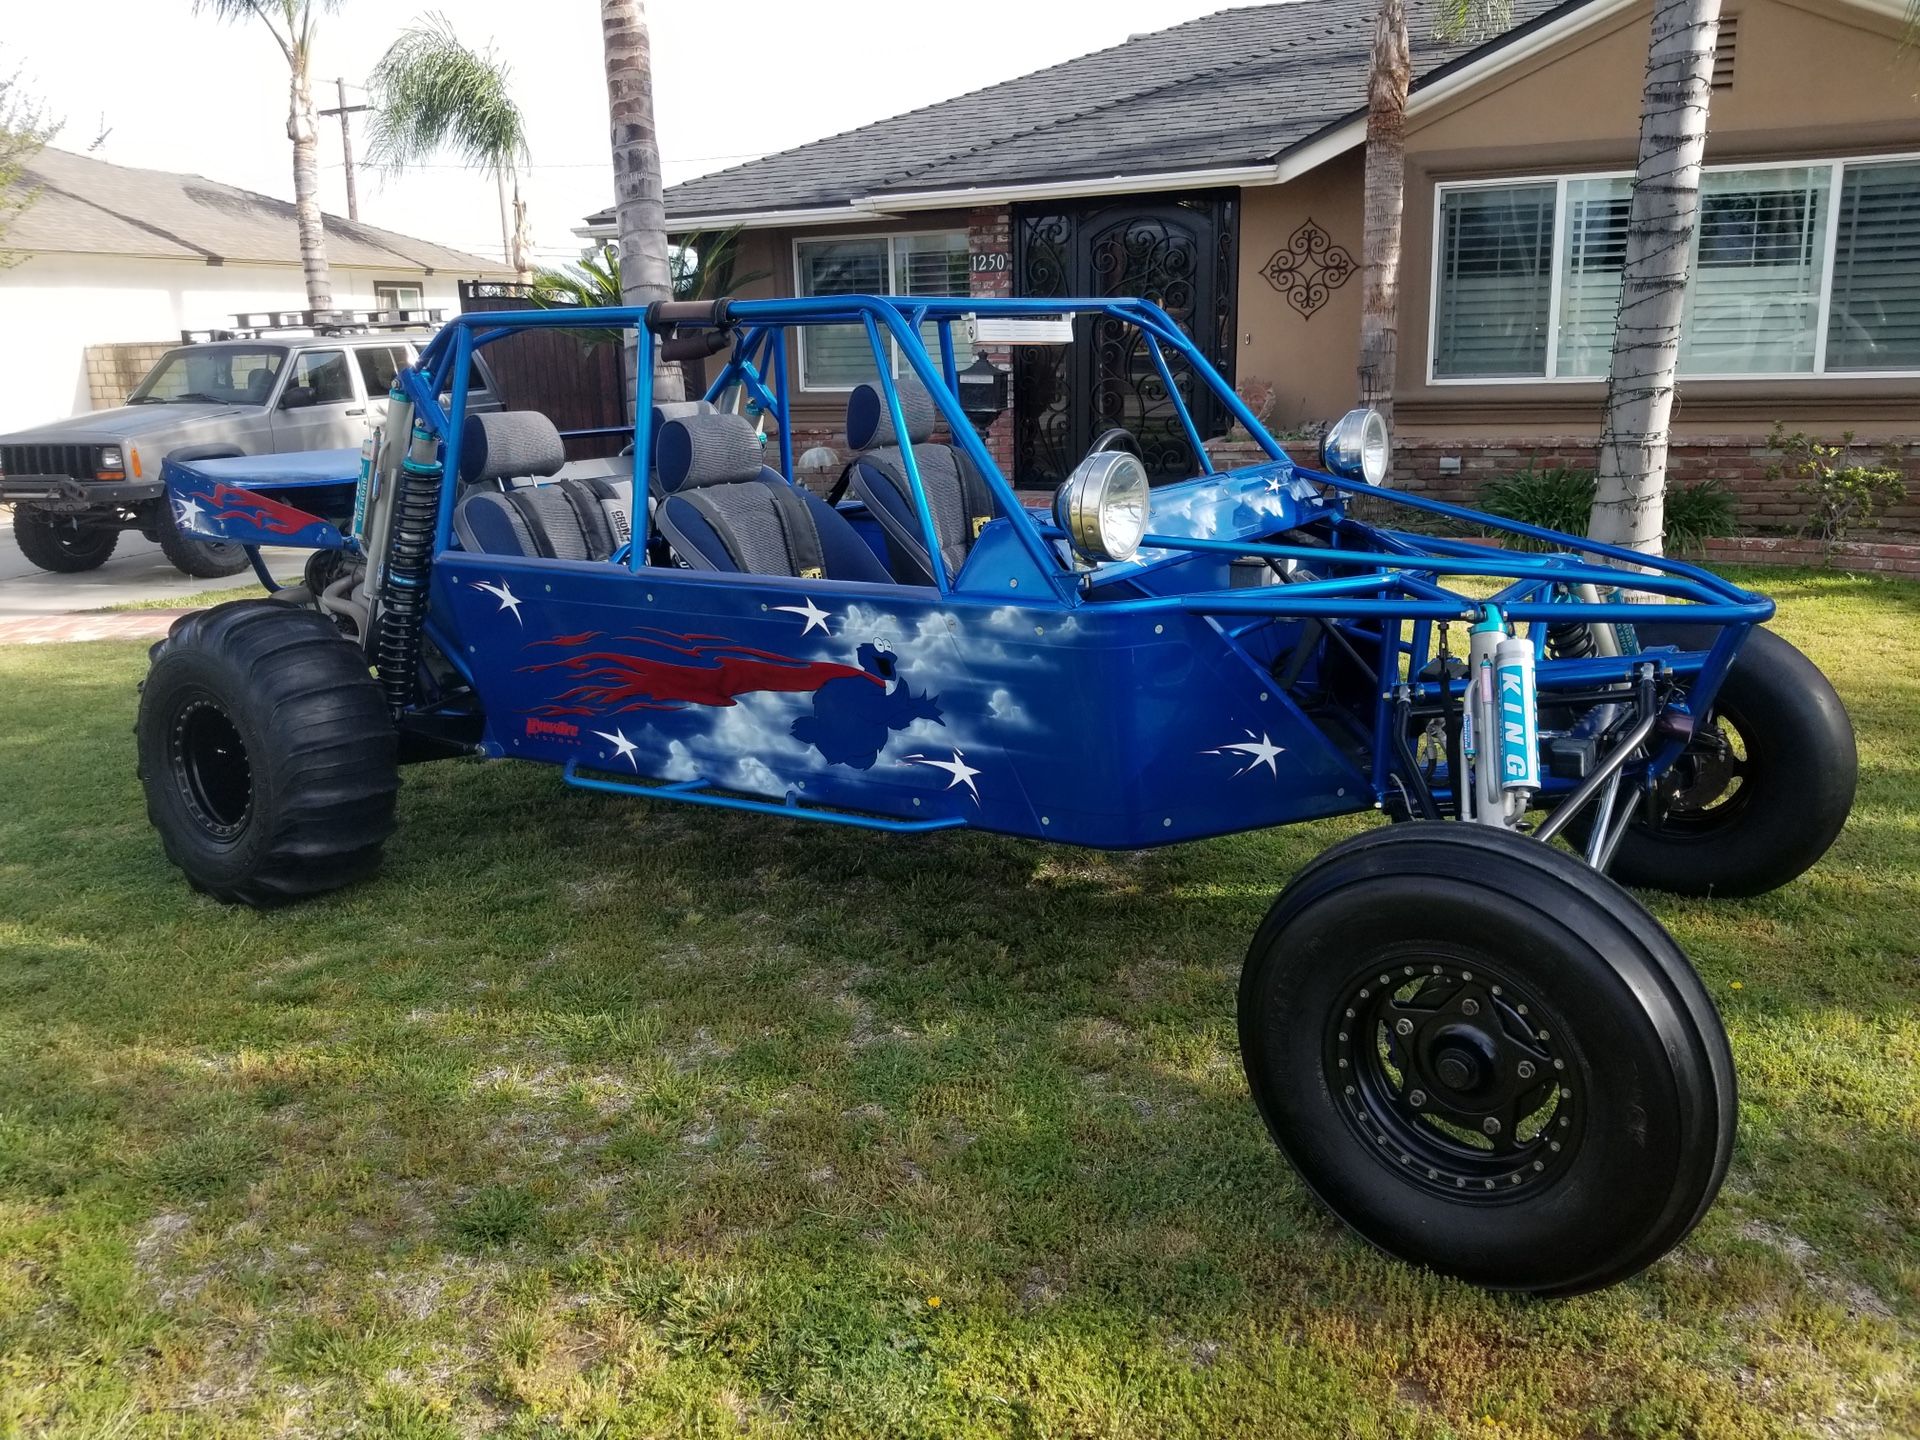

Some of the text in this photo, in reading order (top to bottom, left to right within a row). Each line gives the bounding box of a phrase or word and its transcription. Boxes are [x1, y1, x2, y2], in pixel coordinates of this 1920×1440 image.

[972, 253, 1005, 271] 1250
[357, 477, 368, 521] OFF-ROAD
[1502, 672, 1527, 777] KING
